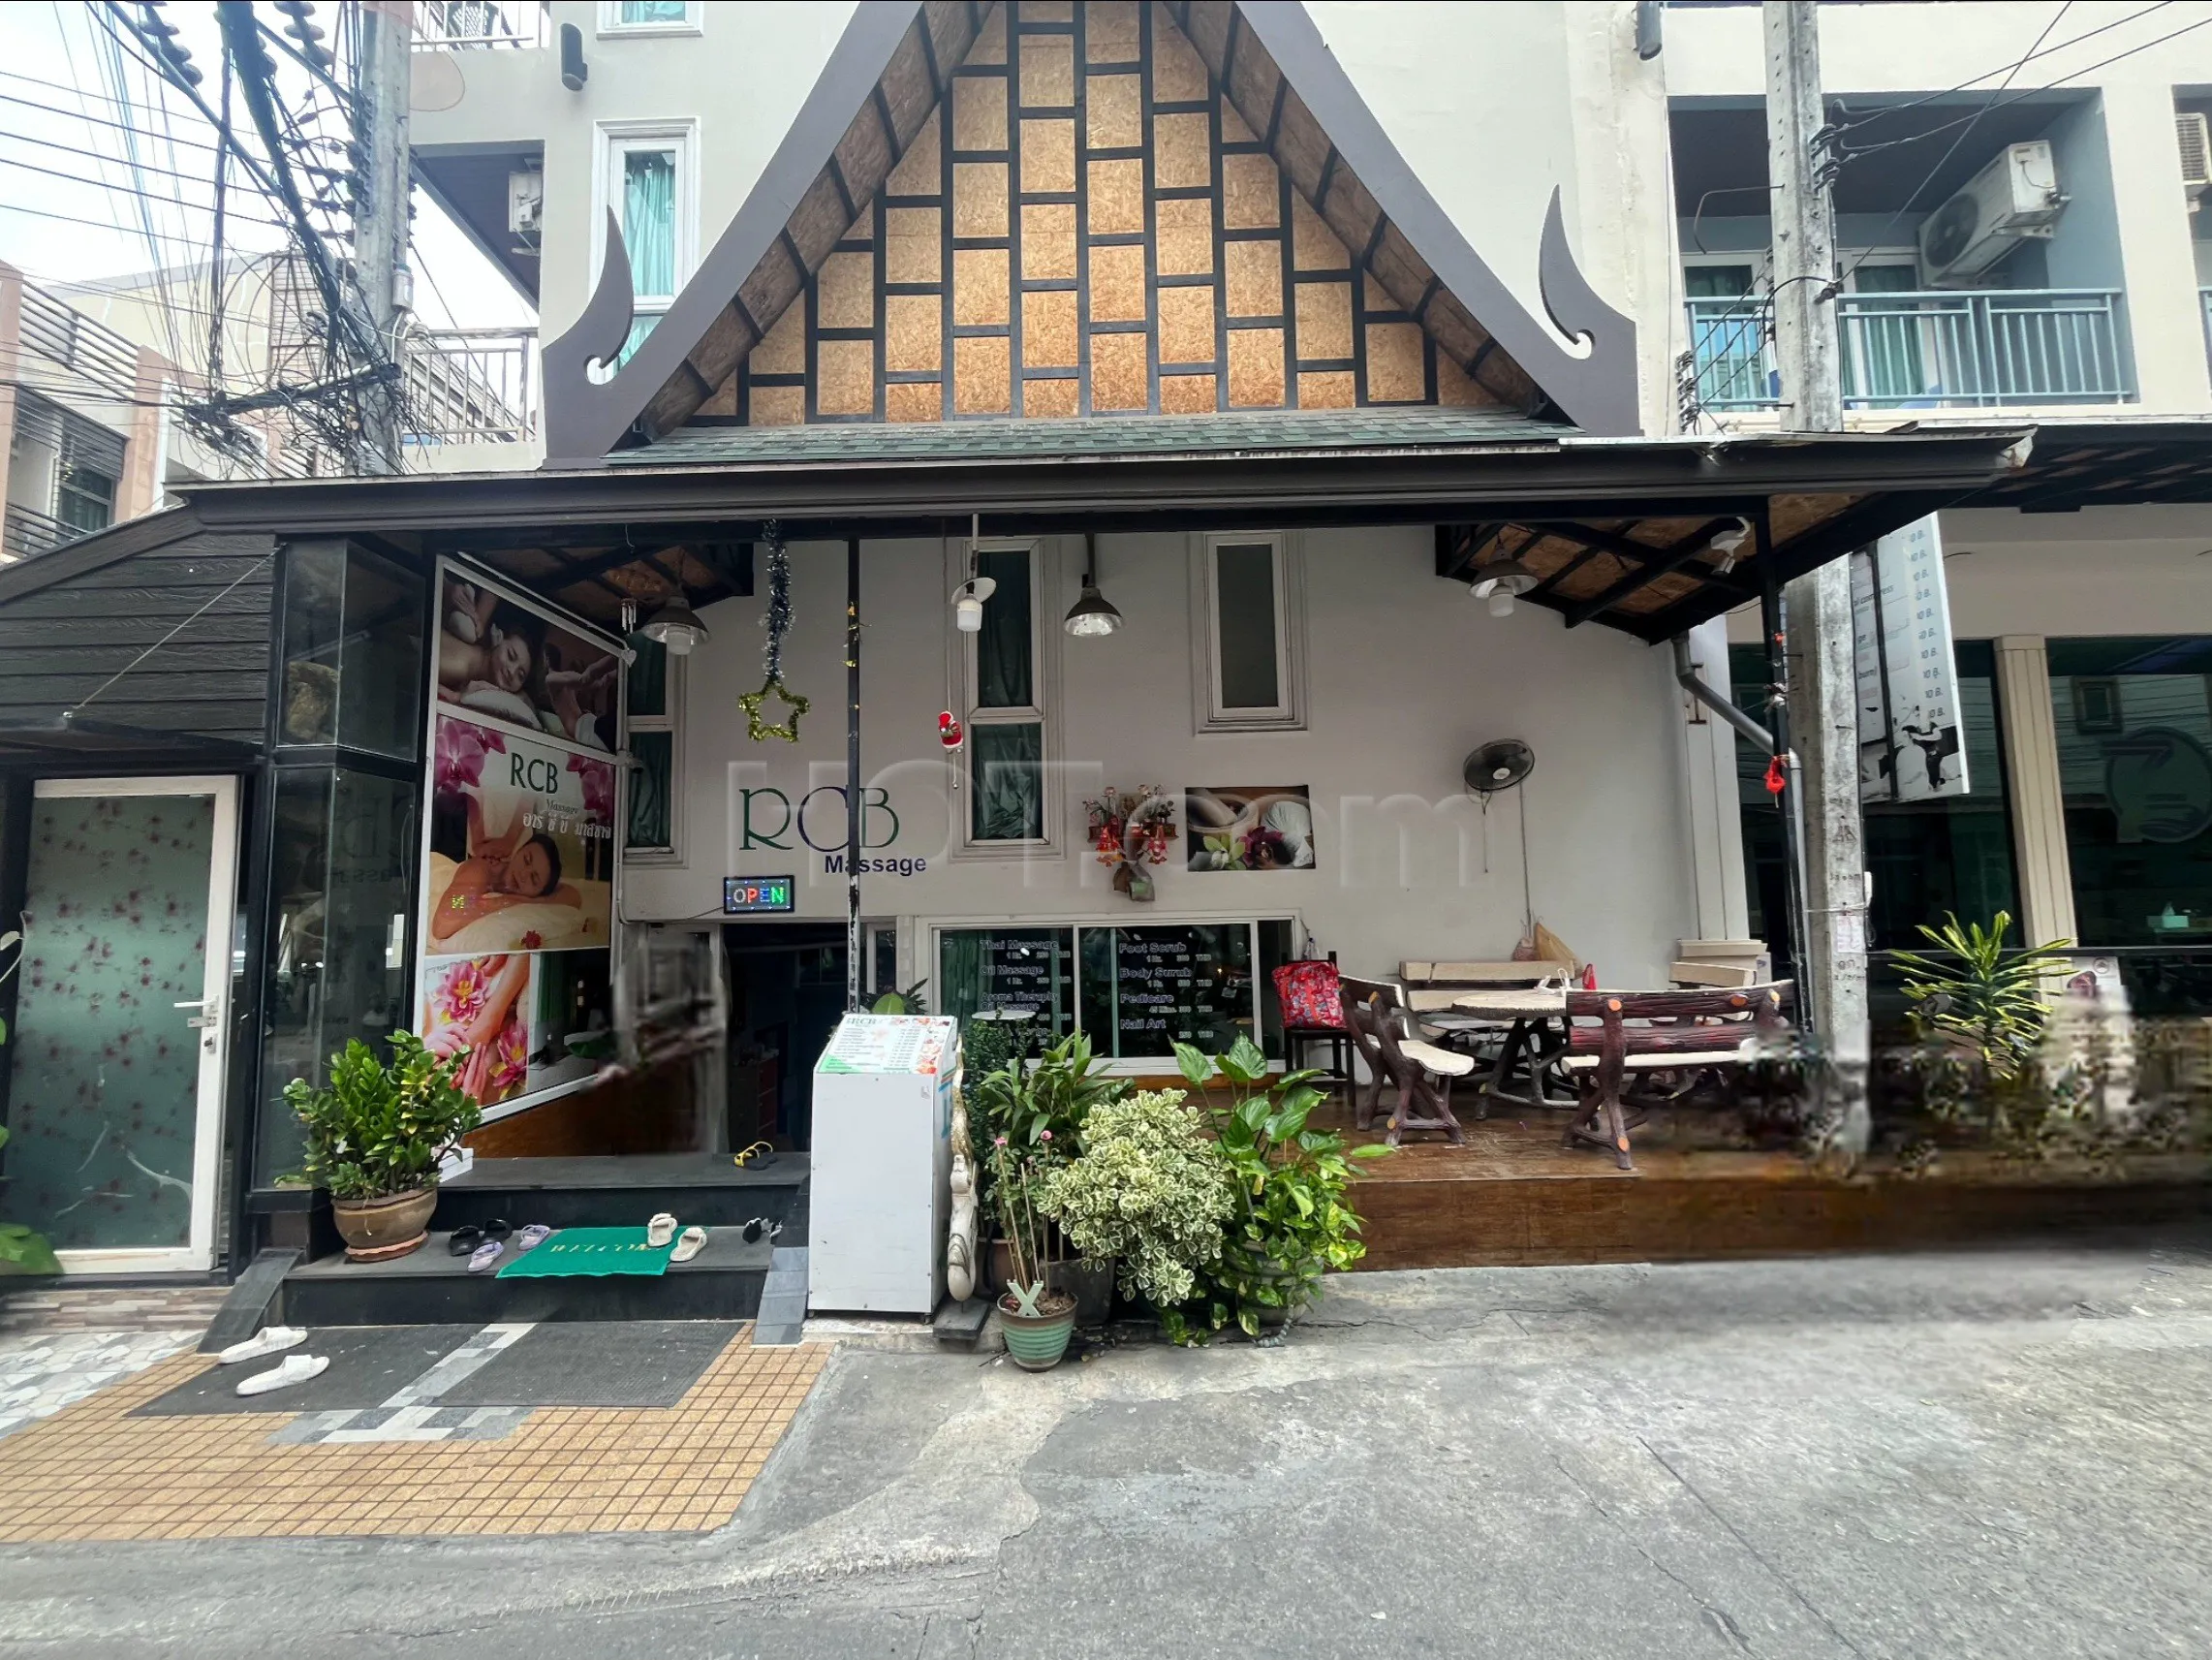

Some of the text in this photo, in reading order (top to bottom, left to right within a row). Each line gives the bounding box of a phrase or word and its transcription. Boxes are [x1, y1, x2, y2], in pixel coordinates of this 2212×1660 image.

[510, 752, 559, 795] RCB
[739, 786, 899, 852] RCB
[825, 855, 926, 876] Mssage
[732, 887, 786, 904] OPEN
[980, 939, 1059, 951] Thai Massage
[1119, 942, 1187, 954] Foot Scrub
[980, 965, 1044, 977] Oil Massage
[1119, 967, 1153, 980] Body
[981, 992, 1013, 1001] Aroma
[1120, 1018, 1167, 1029] Nail Art
